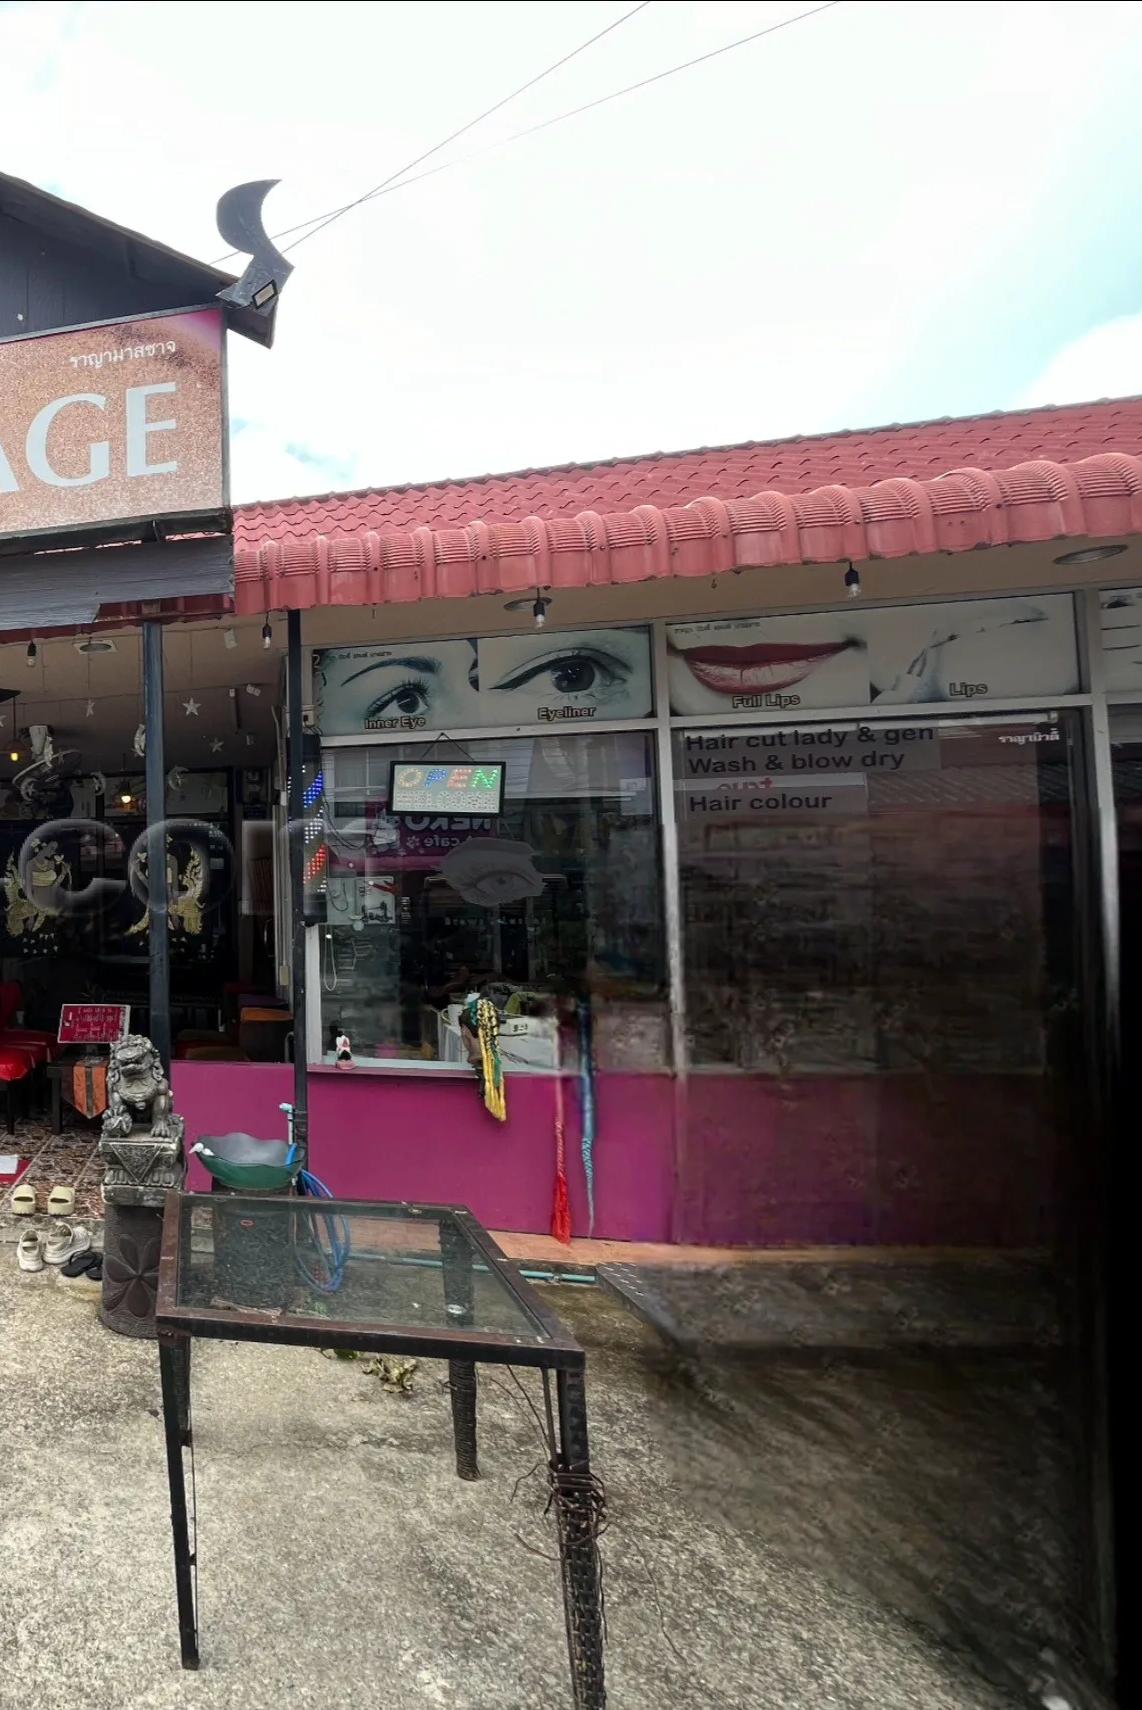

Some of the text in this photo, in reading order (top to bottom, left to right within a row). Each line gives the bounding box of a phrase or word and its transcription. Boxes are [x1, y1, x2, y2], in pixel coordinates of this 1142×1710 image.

[949, 682, 988, 697] Lips
[732, 694, 800, 709] Full Lips
[538, 706, 596, 721] Eyeliner
[364, 716, 426, 730] Inner Eye
[686, 734, 739, 751] Hair
[745, 731, 787, 748] cut
[793, 729, 848, 748] lady
[857, 726, 876, 743] &
[689, 750, 905, 773] Wash & blow dry
[398, 767, 498, 789] OPEN
[689, 793, 832, 812] Hair colour
